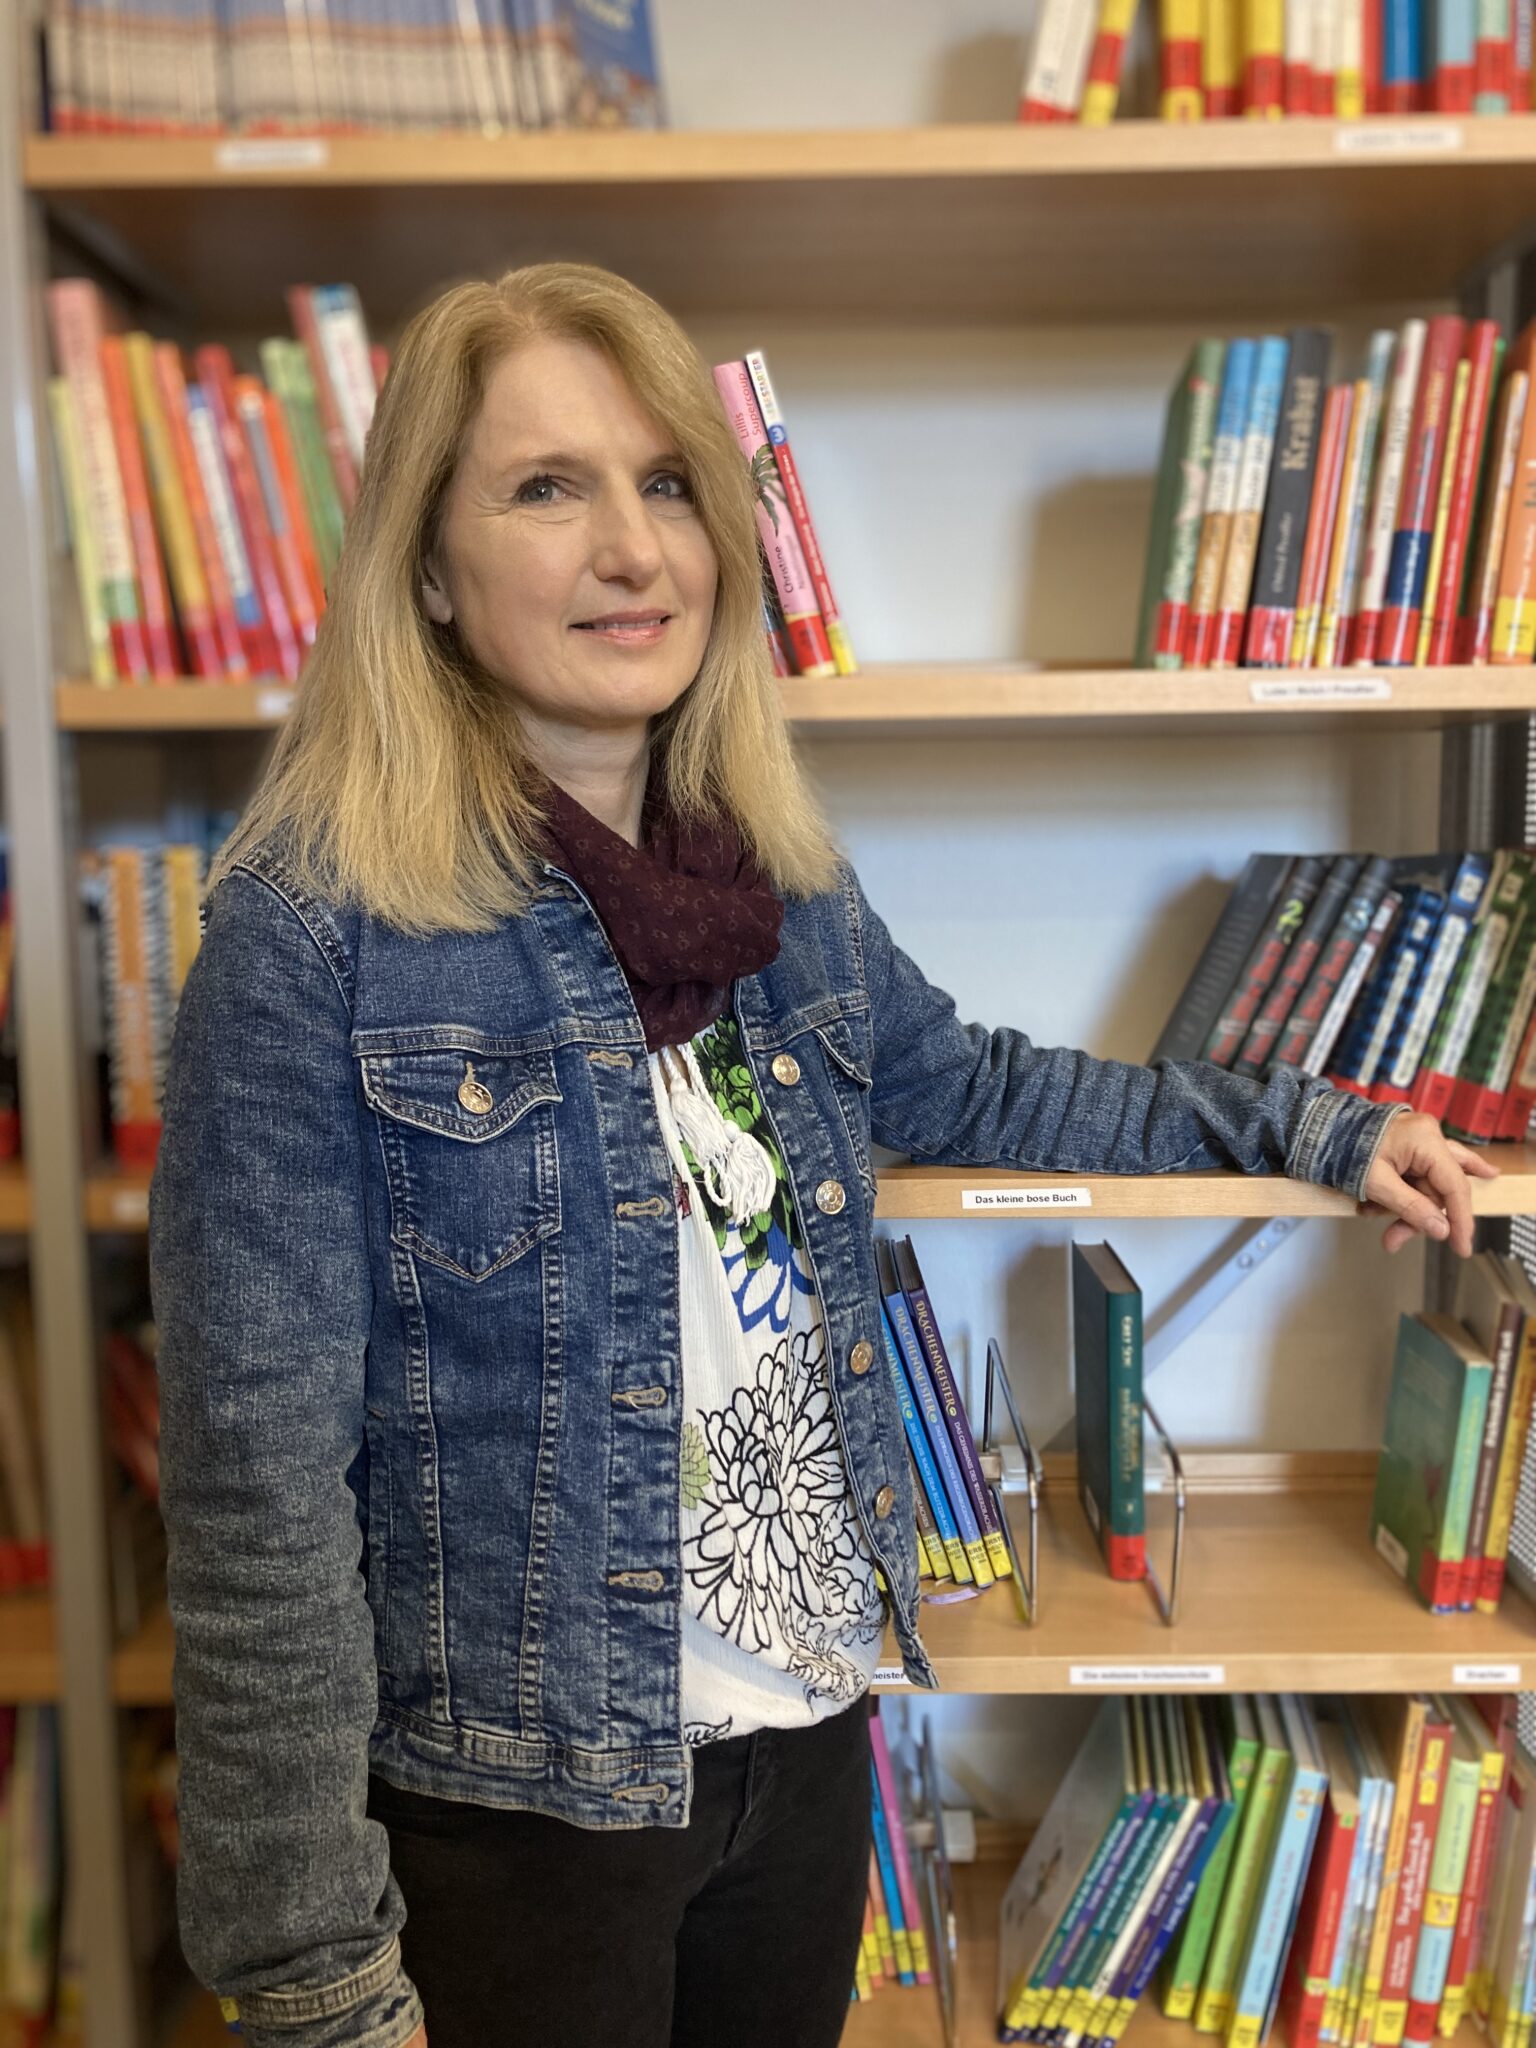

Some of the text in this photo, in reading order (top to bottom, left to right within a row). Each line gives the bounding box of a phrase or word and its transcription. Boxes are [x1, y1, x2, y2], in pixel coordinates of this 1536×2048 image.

[735, 412, 750, 440] Lillis
[738, 373, 762, 436] Supercoup
[775, 546, 794, 594] Christine
[975, 1195, 994, 1204] Das
[996, 1195, 1024, 1203] kleine
[1052, 1194, 1077, 1202] Buch
[895, 1306, 937, 1420] DRACHENMEISTER
[916, 1300, 956, 1416] DRACHENMEISTER
[958, 1435, 974, 1470] GEHEIMNIS
[953, 1481, 976, 1538] REGENBOGENDRACH
